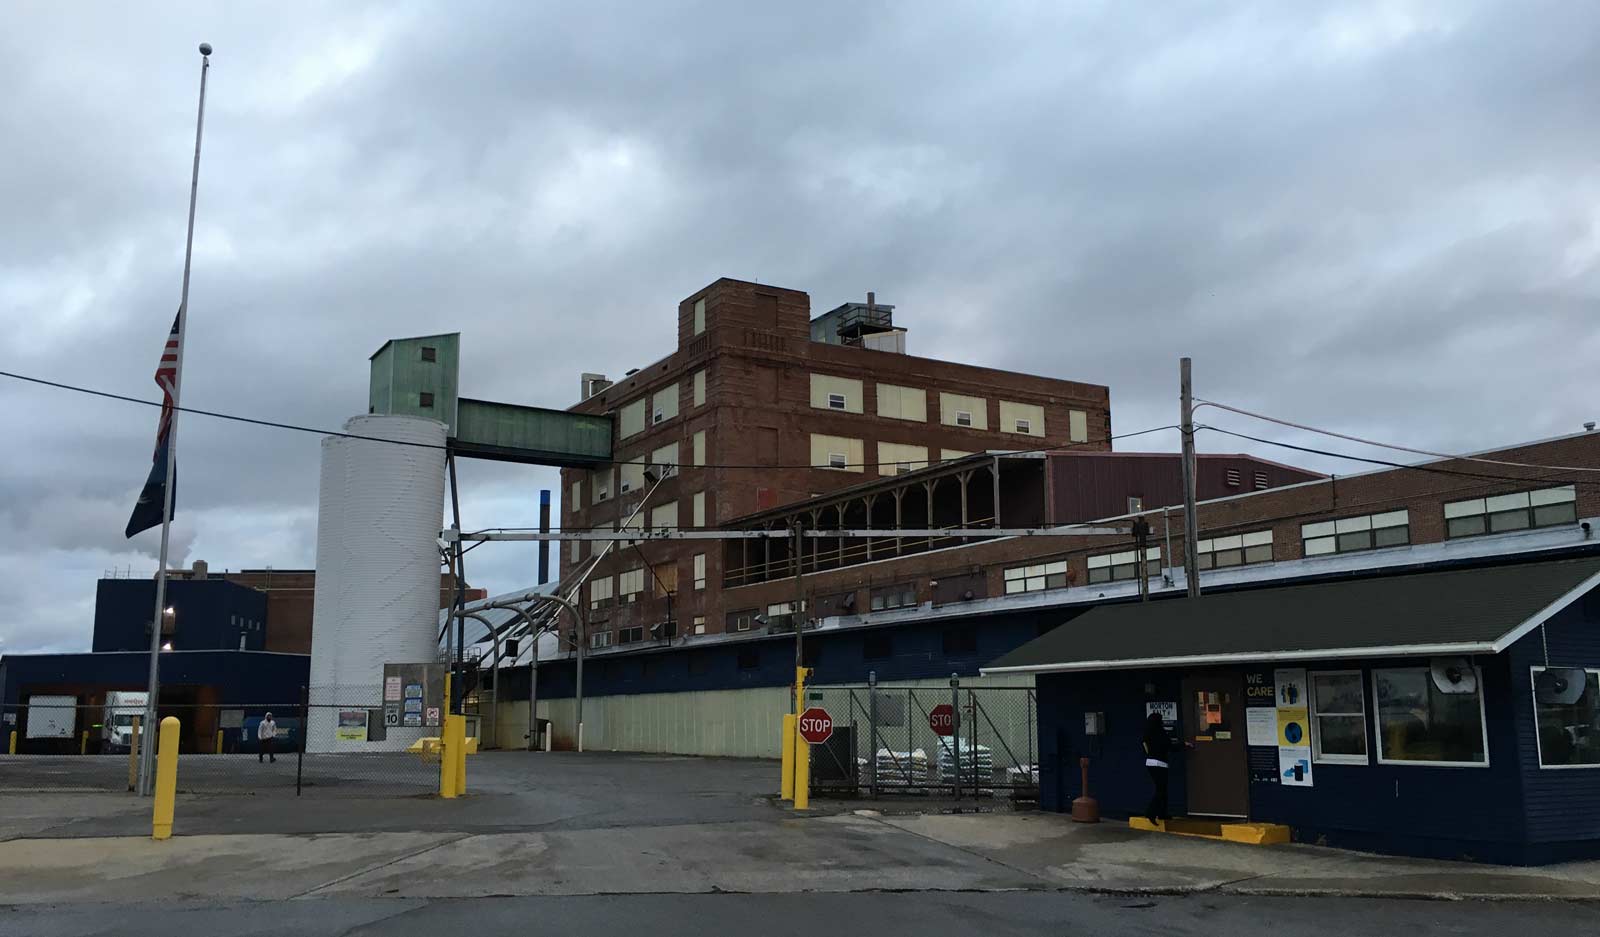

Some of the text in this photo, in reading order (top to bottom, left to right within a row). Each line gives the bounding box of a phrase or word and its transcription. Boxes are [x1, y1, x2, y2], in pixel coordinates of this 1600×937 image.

[1246, 673, 1263, 684] WE
[1247, 686, 1274, 697] CARE
[386, 714, 398, 724] 10
[931, 714, 953, 727] STO
[801, 718, 831, 733] STOP
